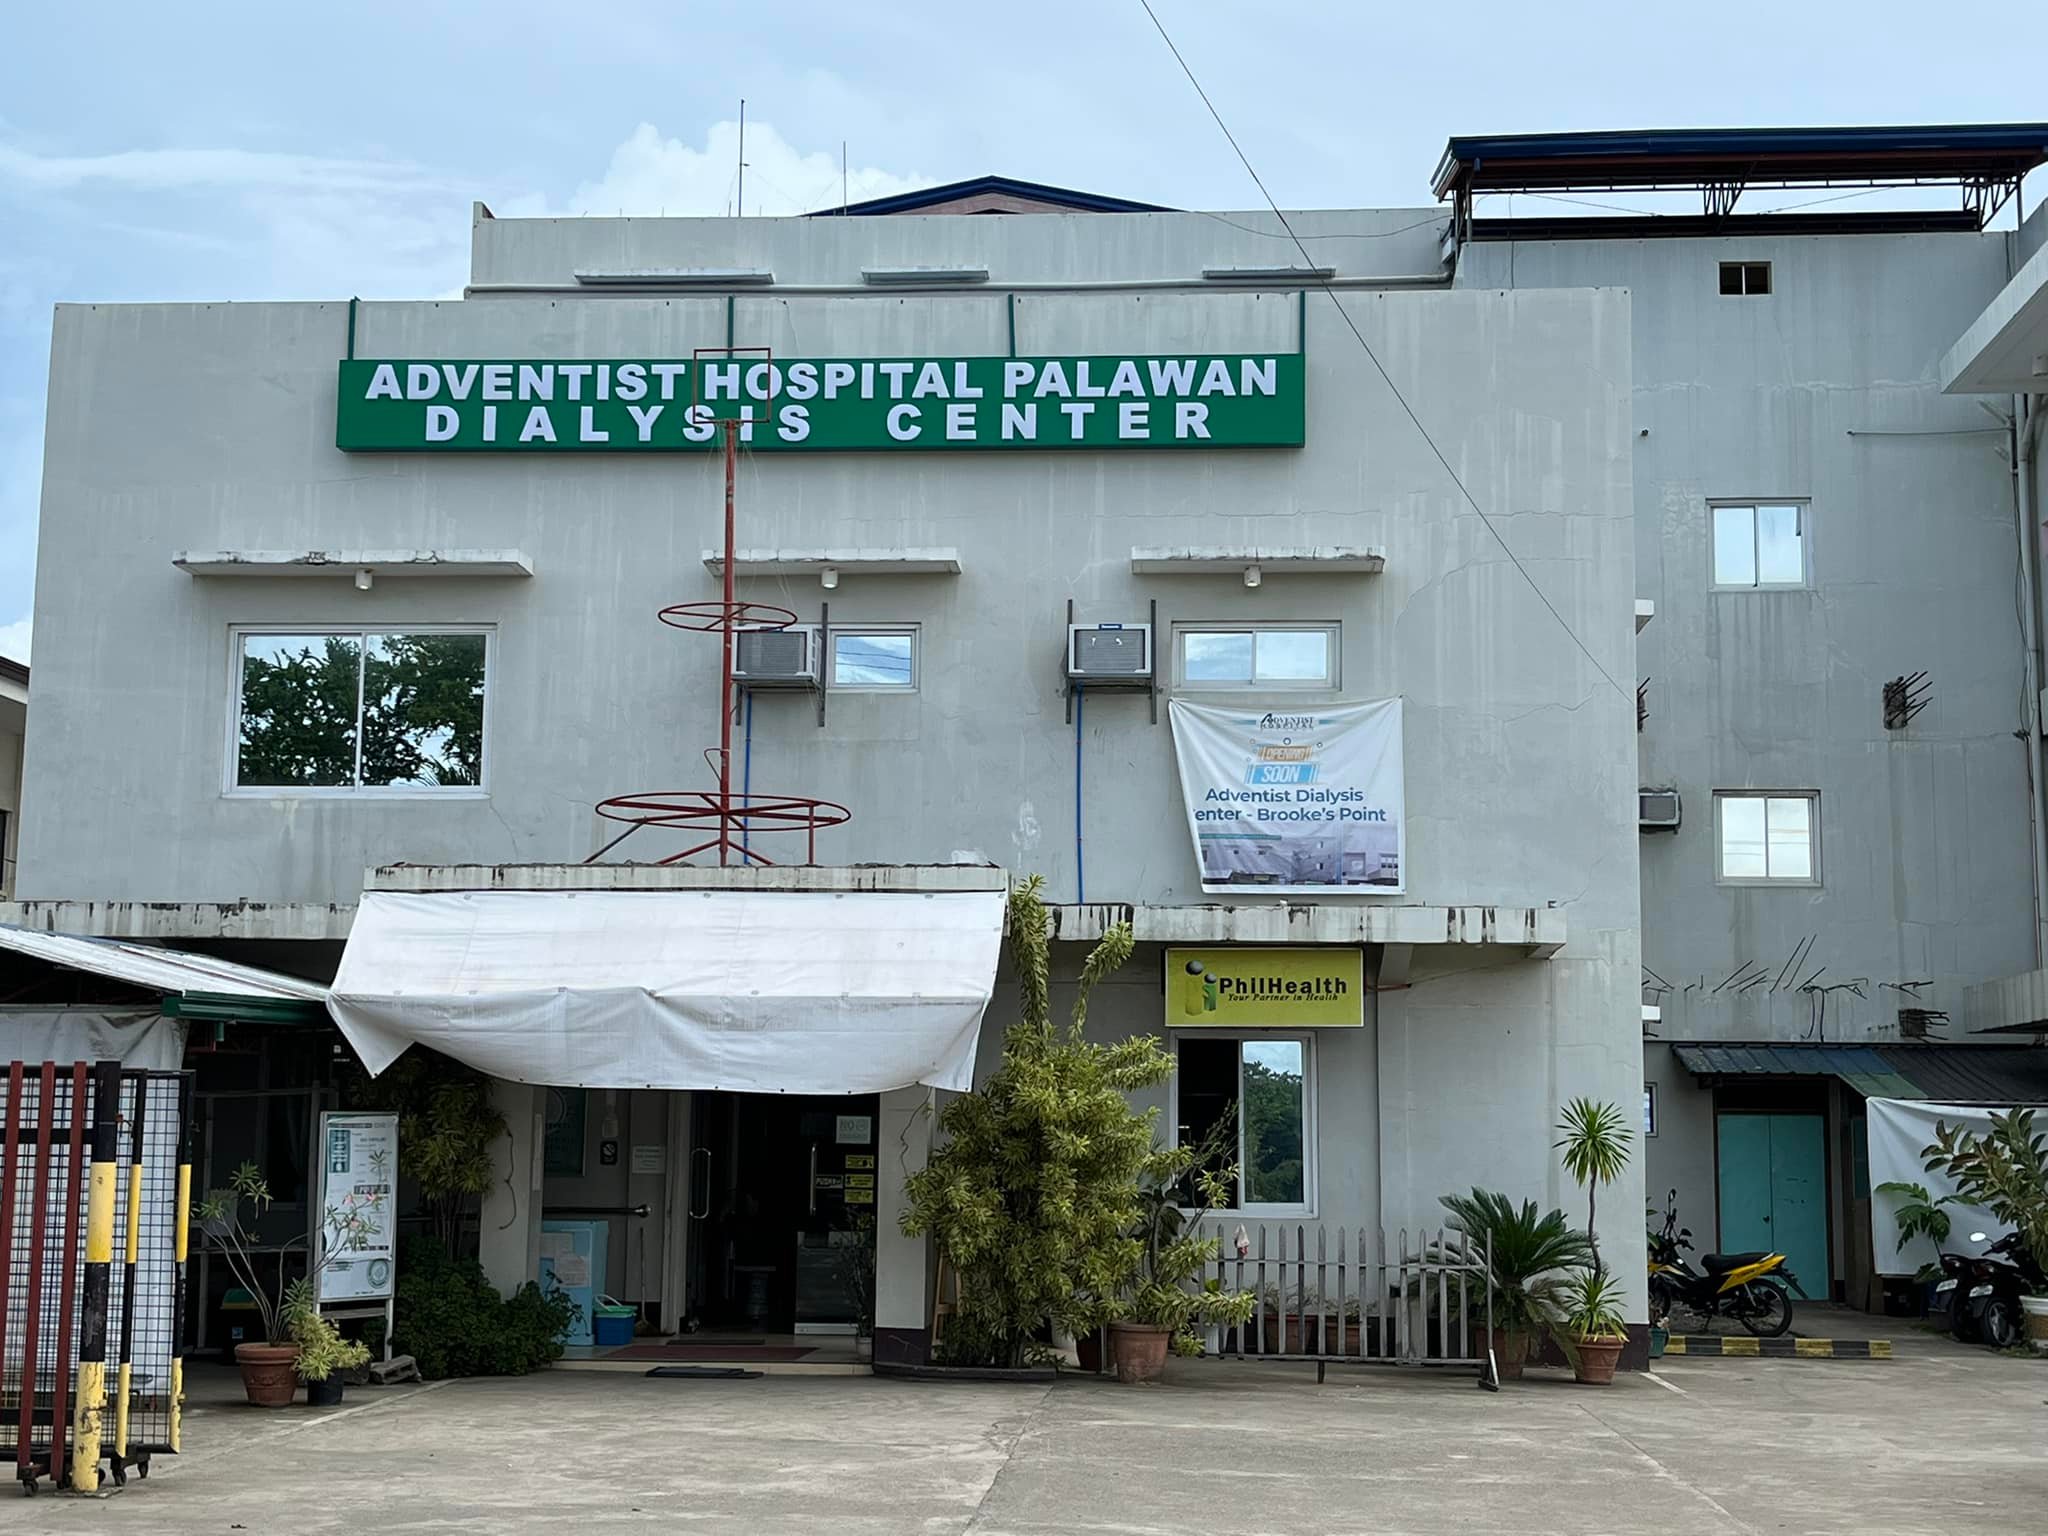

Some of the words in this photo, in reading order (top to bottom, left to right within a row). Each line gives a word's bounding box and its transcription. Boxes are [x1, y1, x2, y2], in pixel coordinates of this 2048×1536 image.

[364, 364, 686, 401] ADVENTIST
[704, 361, 984, 400] HOSPITAL
[1003, 359, 1277, 398] PALAWAN
[425, 404, 811, 442] DIALYSIS
[886, 402, 1212, 441] CENTER
[1261, 765, 1300, 783] SOON
[1205, 788, 1291, 802] Adventist
[1296, 787, 1364, 805] Dialysis
[1193, 808, 1242, 821] enter
[1257, 807, 1335, 821] Brooke's
[1340, 806, 1387, 822] Point
[1219, 977, 1347, 994] PhilHealth
[1228, 993, 1249, 1001] Your
[1253, 993, 1289, 1001] Partner
[1293, 993, 1302, 1001] in
[1306, 993, 1338, 1001] Health
